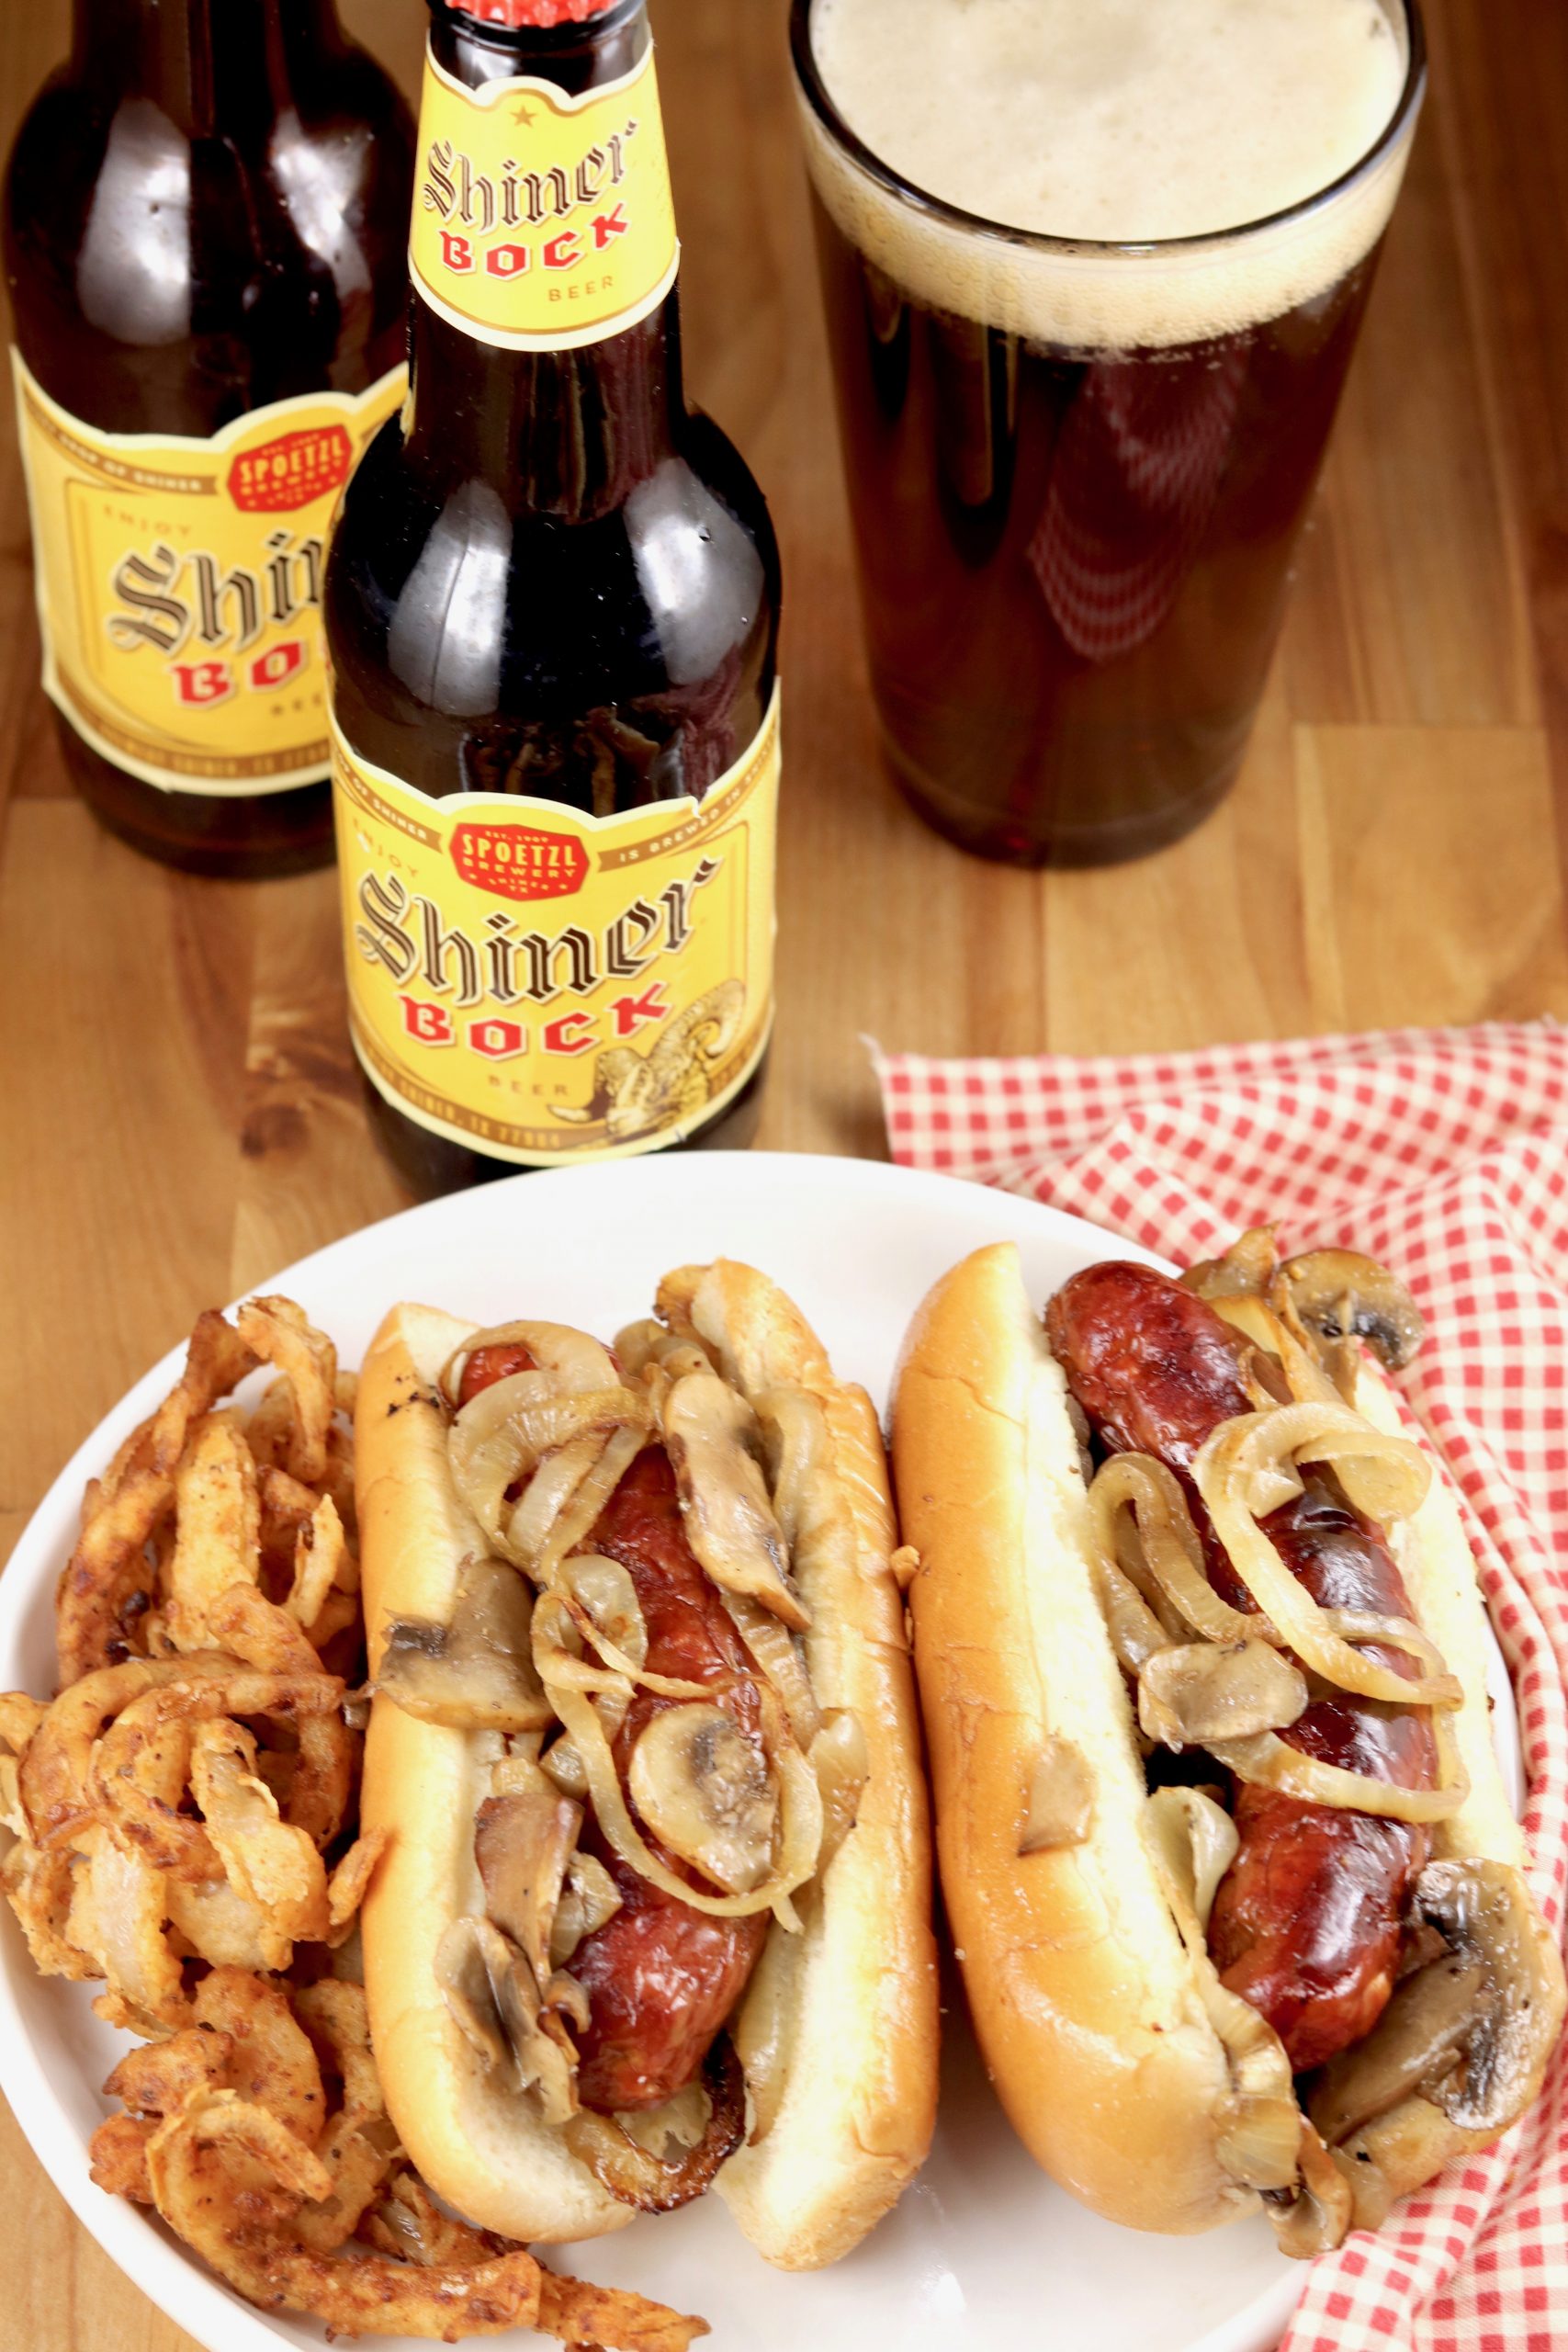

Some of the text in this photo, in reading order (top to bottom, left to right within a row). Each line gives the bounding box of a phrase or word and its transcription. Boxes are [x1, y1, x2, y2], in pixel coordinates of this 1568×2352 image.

[423, 119, 637, 231] Shiner
[438, 202, 629, 277] BOCK
[547, 275, 615, 302] BEER
[239, 434, 344, 485] SPOETZL
[461, 832, 578, 867] SPOETZL
[462, 856, 576, 878] BREWERY
[619, 848, 639, 863] IS
[355, 855, 722, 1003] Shiner
[399, 982, 671, 1057] BOCK
[487, 1074, 570, 1097] BEER
